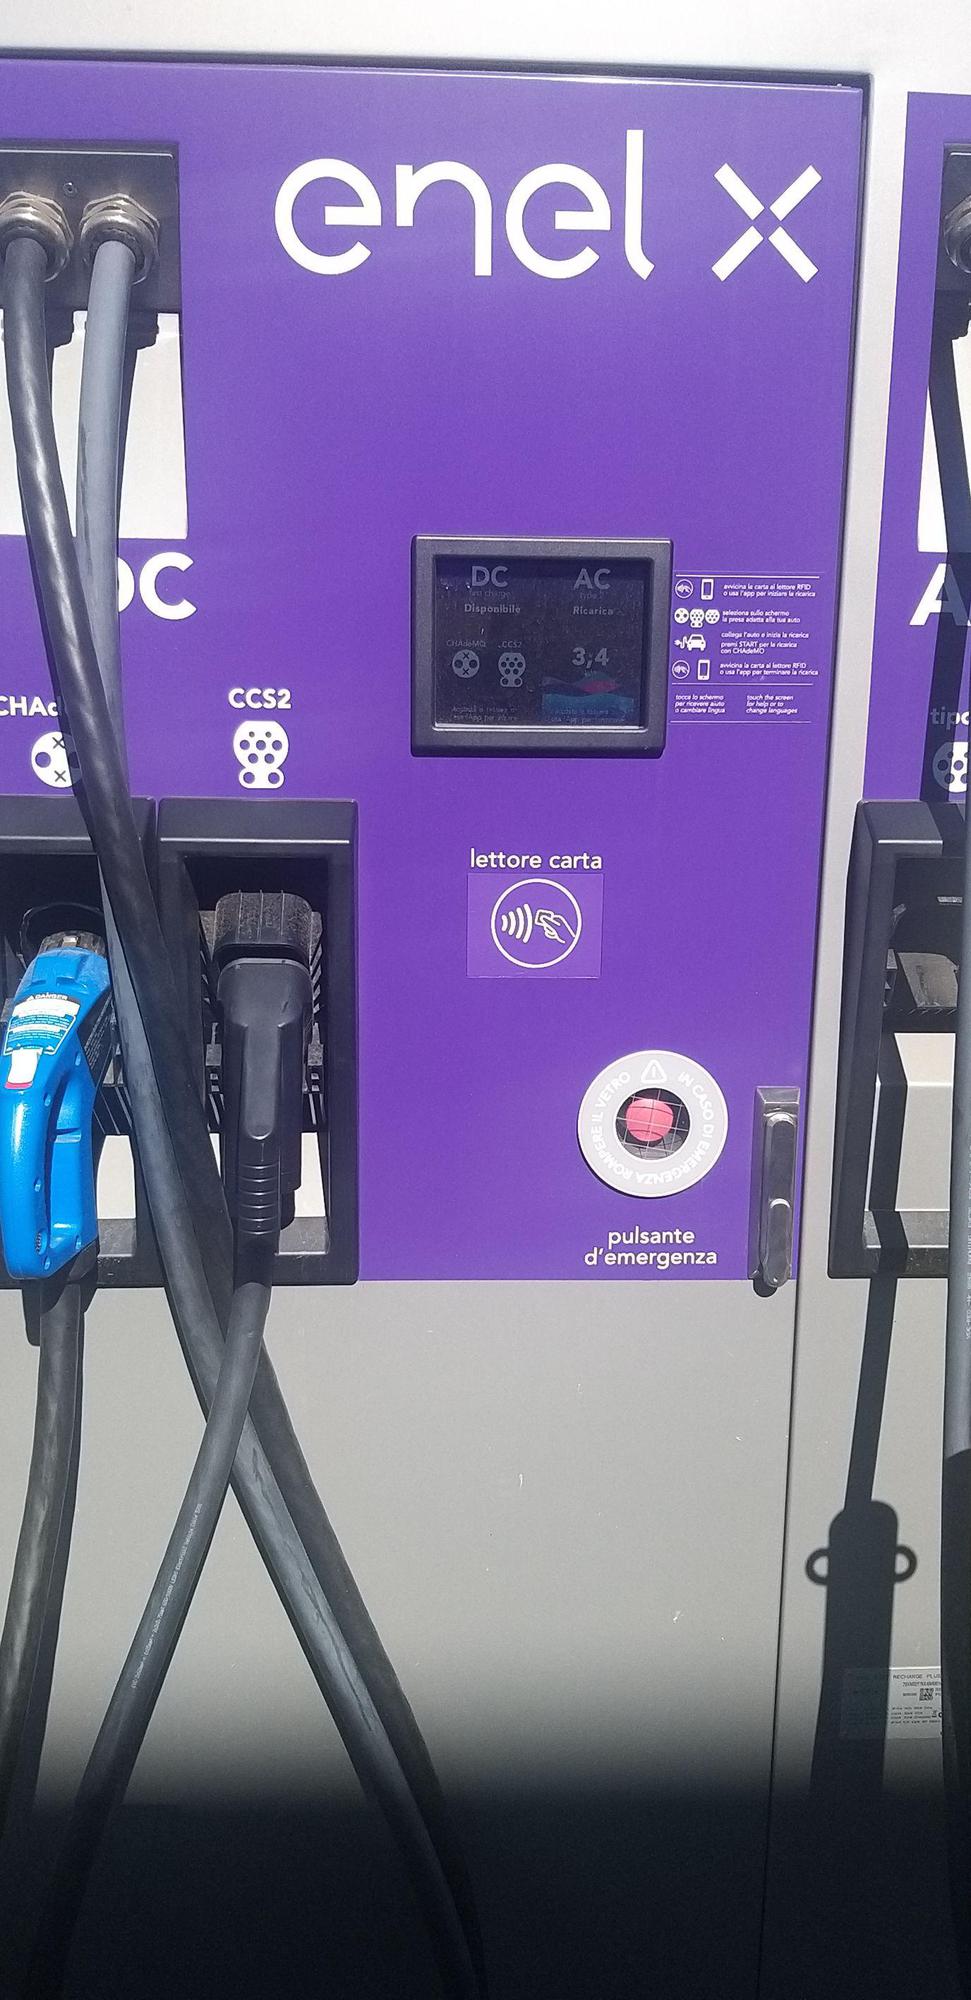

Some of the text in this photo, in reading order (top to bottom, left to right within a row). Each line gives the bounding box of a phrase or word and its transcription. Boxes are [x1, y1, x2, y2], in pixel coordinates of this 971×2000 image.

[274, 129, 655, 281] enel
[471, 566, 508, 588] DC
[573, 568, 612, 590] AC
[909, 563, 971, 626] A
[464, 603, 521, 616] Disponibile
[573, 606, 614, 616] Ricarica
[228, 688, 292, 709] CCS2
[470, 848, 602, 869] lettore carta
[591, 1072, 714, 1185] IN CASO DI EMERGENZA ROMPERE IL VETRO
[608, 1226, 695, 1249] pulsante
[584, 1247, 717, 1270] d'emergenza
